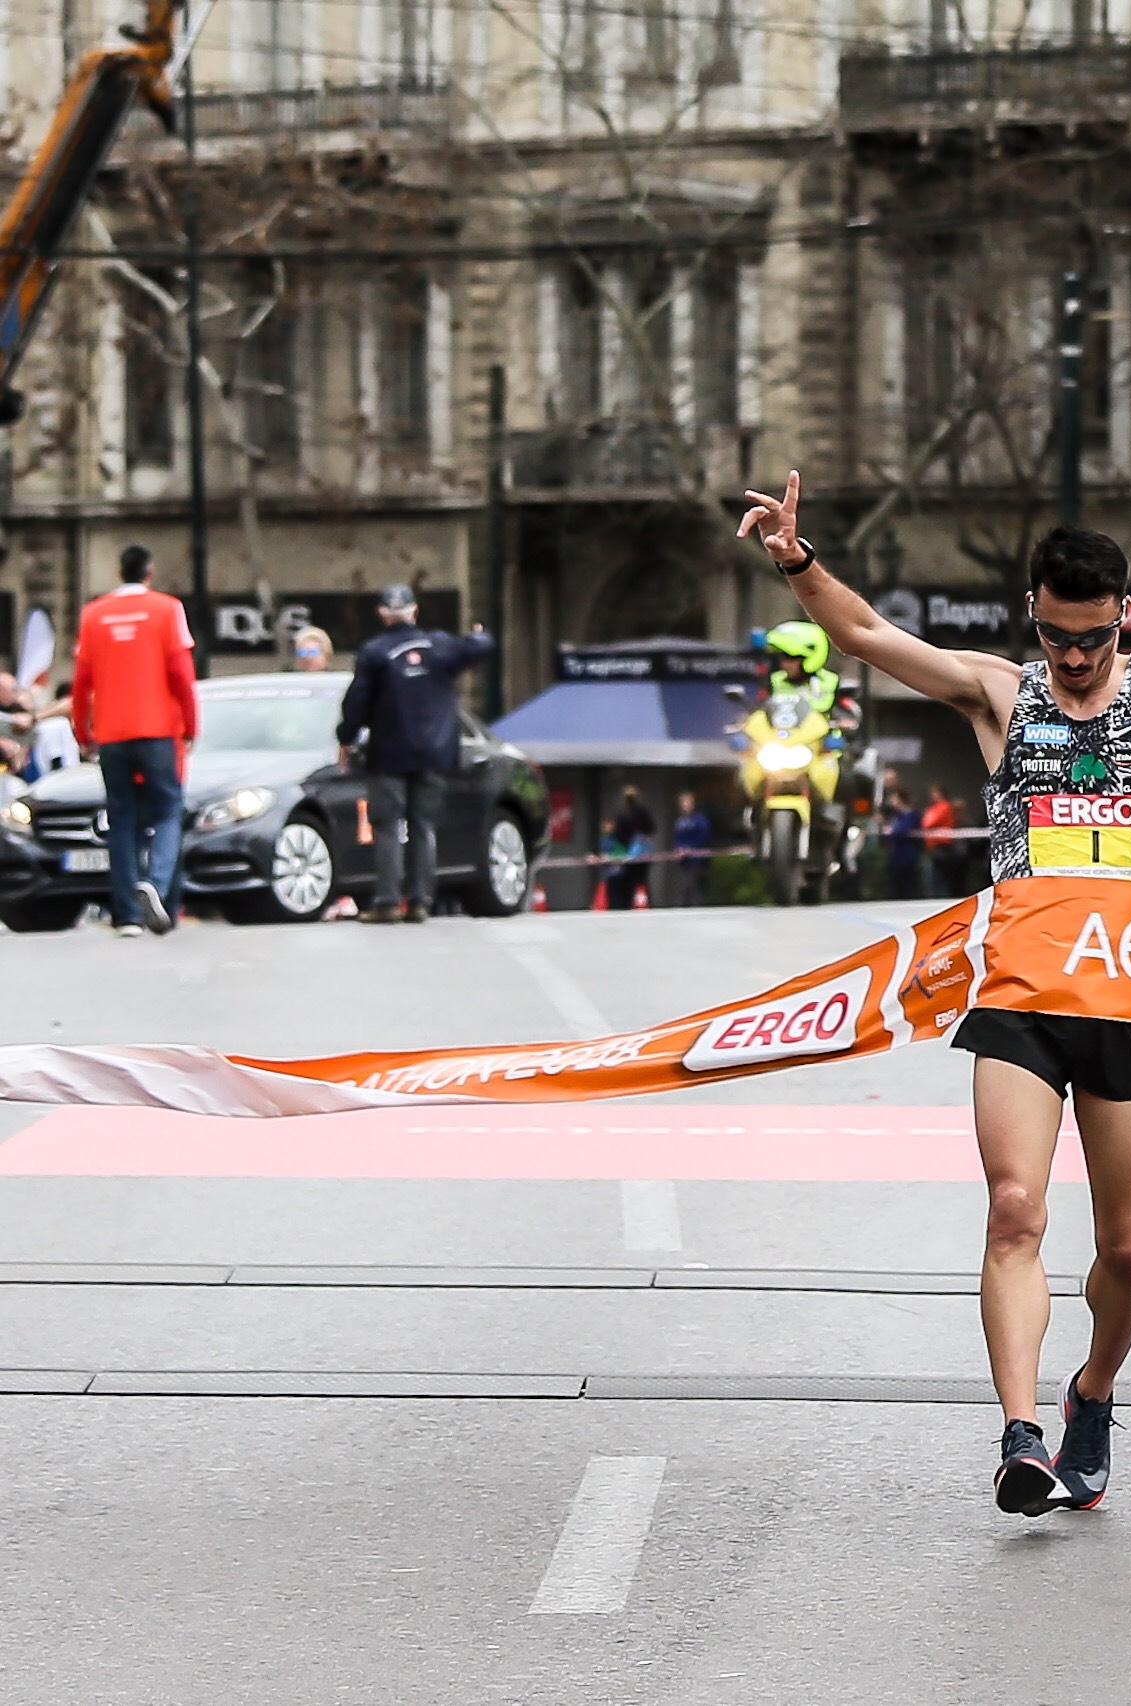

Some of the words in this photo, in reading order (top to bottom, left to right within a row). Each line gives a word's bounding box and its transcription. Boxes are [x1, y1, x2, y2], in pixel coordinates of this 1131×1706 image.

[1026, 727, 1068, 741] WIND
[1022, 759, 1060, 772] PROTEIN
[713, 992, 849, 1050] ERGO
